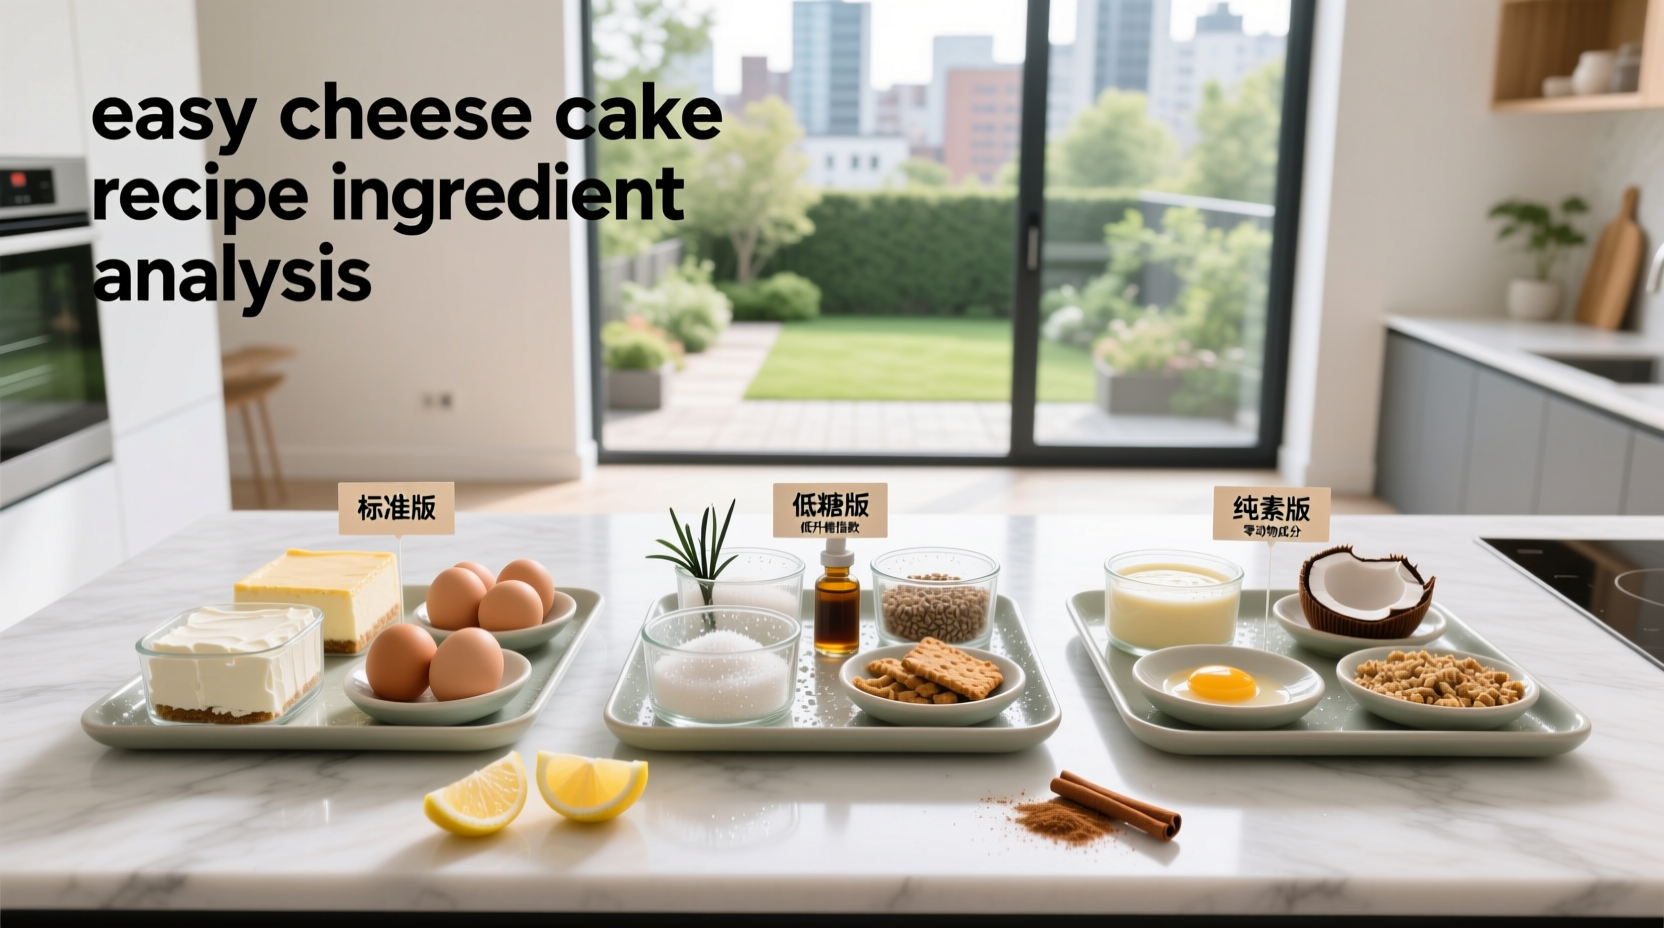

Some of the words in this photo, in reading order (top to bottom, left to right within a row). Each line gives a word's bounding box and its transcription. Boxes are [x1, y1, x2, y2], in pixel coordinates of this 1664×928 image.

[357, 493, 436, 521] 标准版
[792, 491, 869, 518] 低糖版
[1232, 494, 1310, 522] 纯素版
